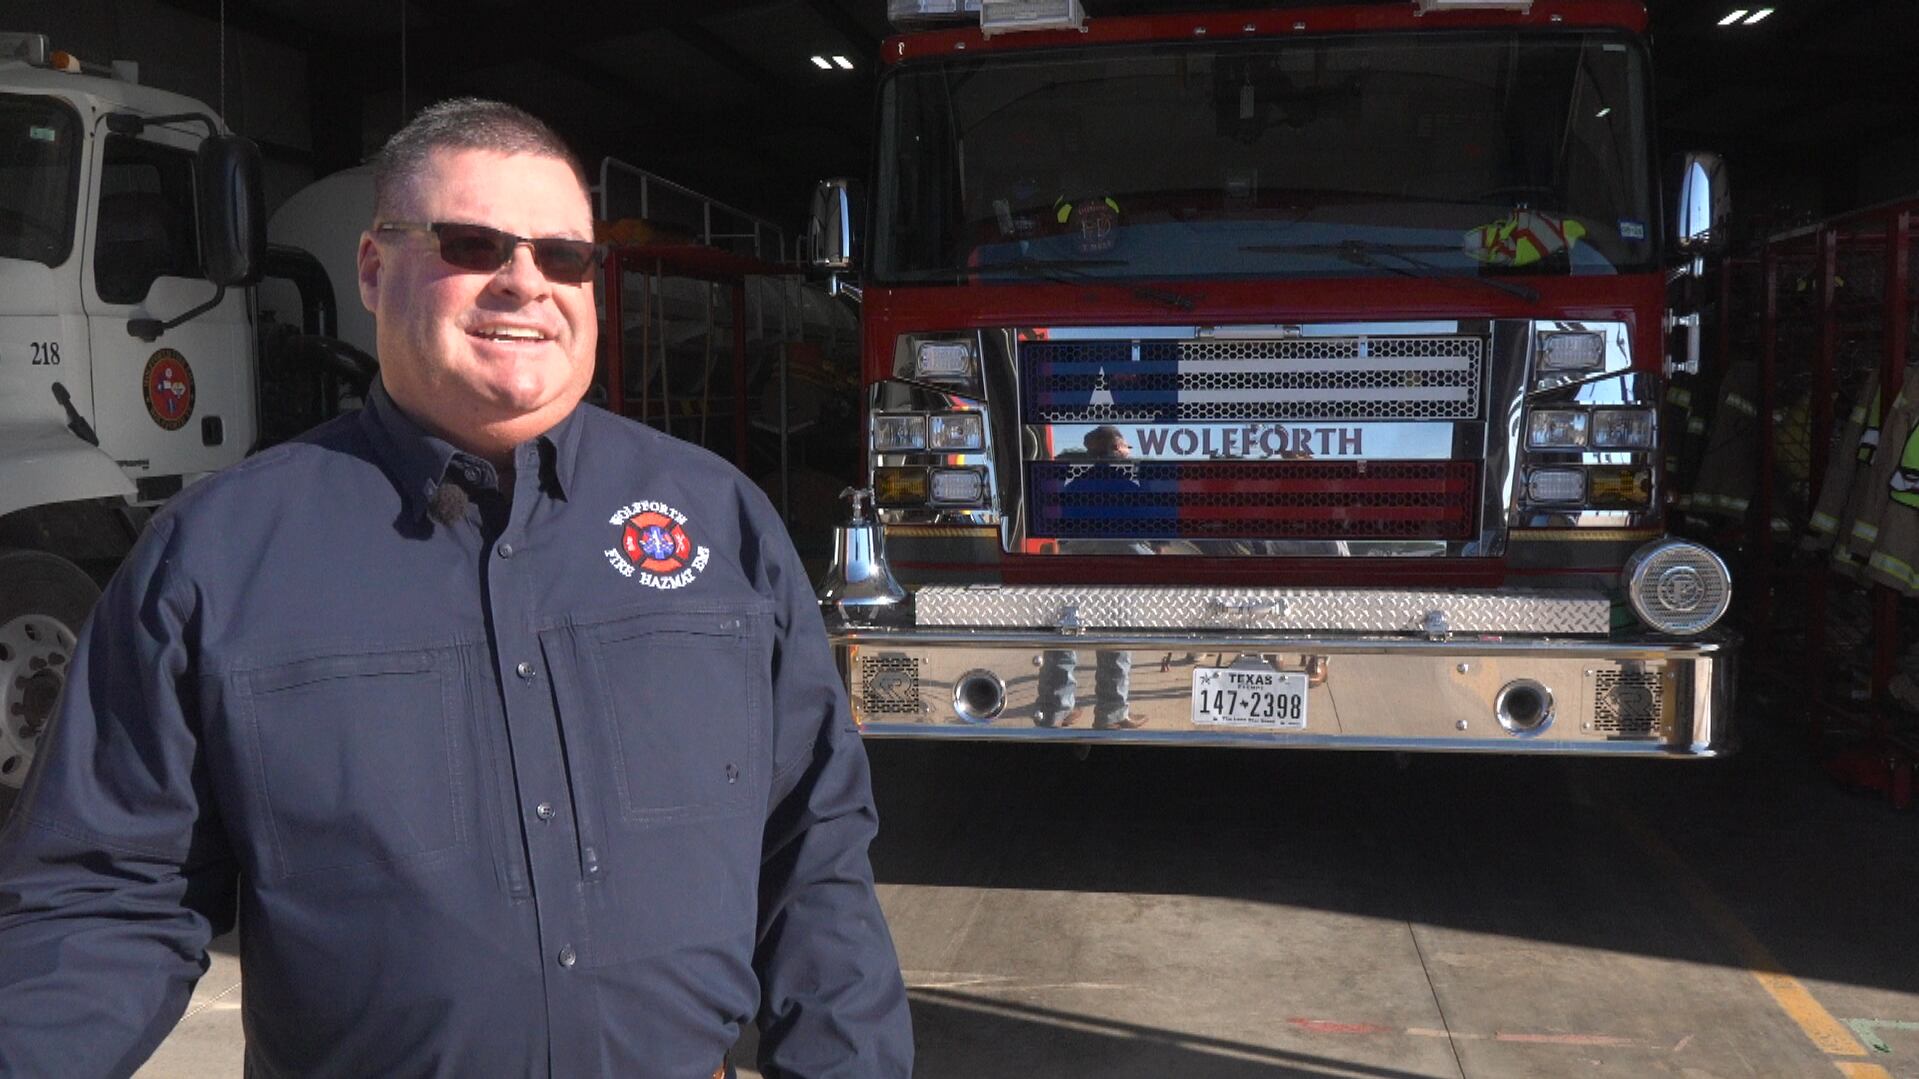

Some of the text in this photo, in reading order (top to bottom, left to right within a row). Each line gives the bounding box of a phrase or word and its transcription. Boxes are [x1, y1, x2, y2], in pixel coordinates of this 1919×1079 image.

[30, 341, 61, 365] 218
[1136, 427, 1363, 456] WOLFFORTH
[609, 500, 688, 525] WOLFFORTH
[604, 548, 635, 577] FIRE
[638, 568, 696, 589] HAZMAT
[1229, 674, 1273, 685] TEXAS
